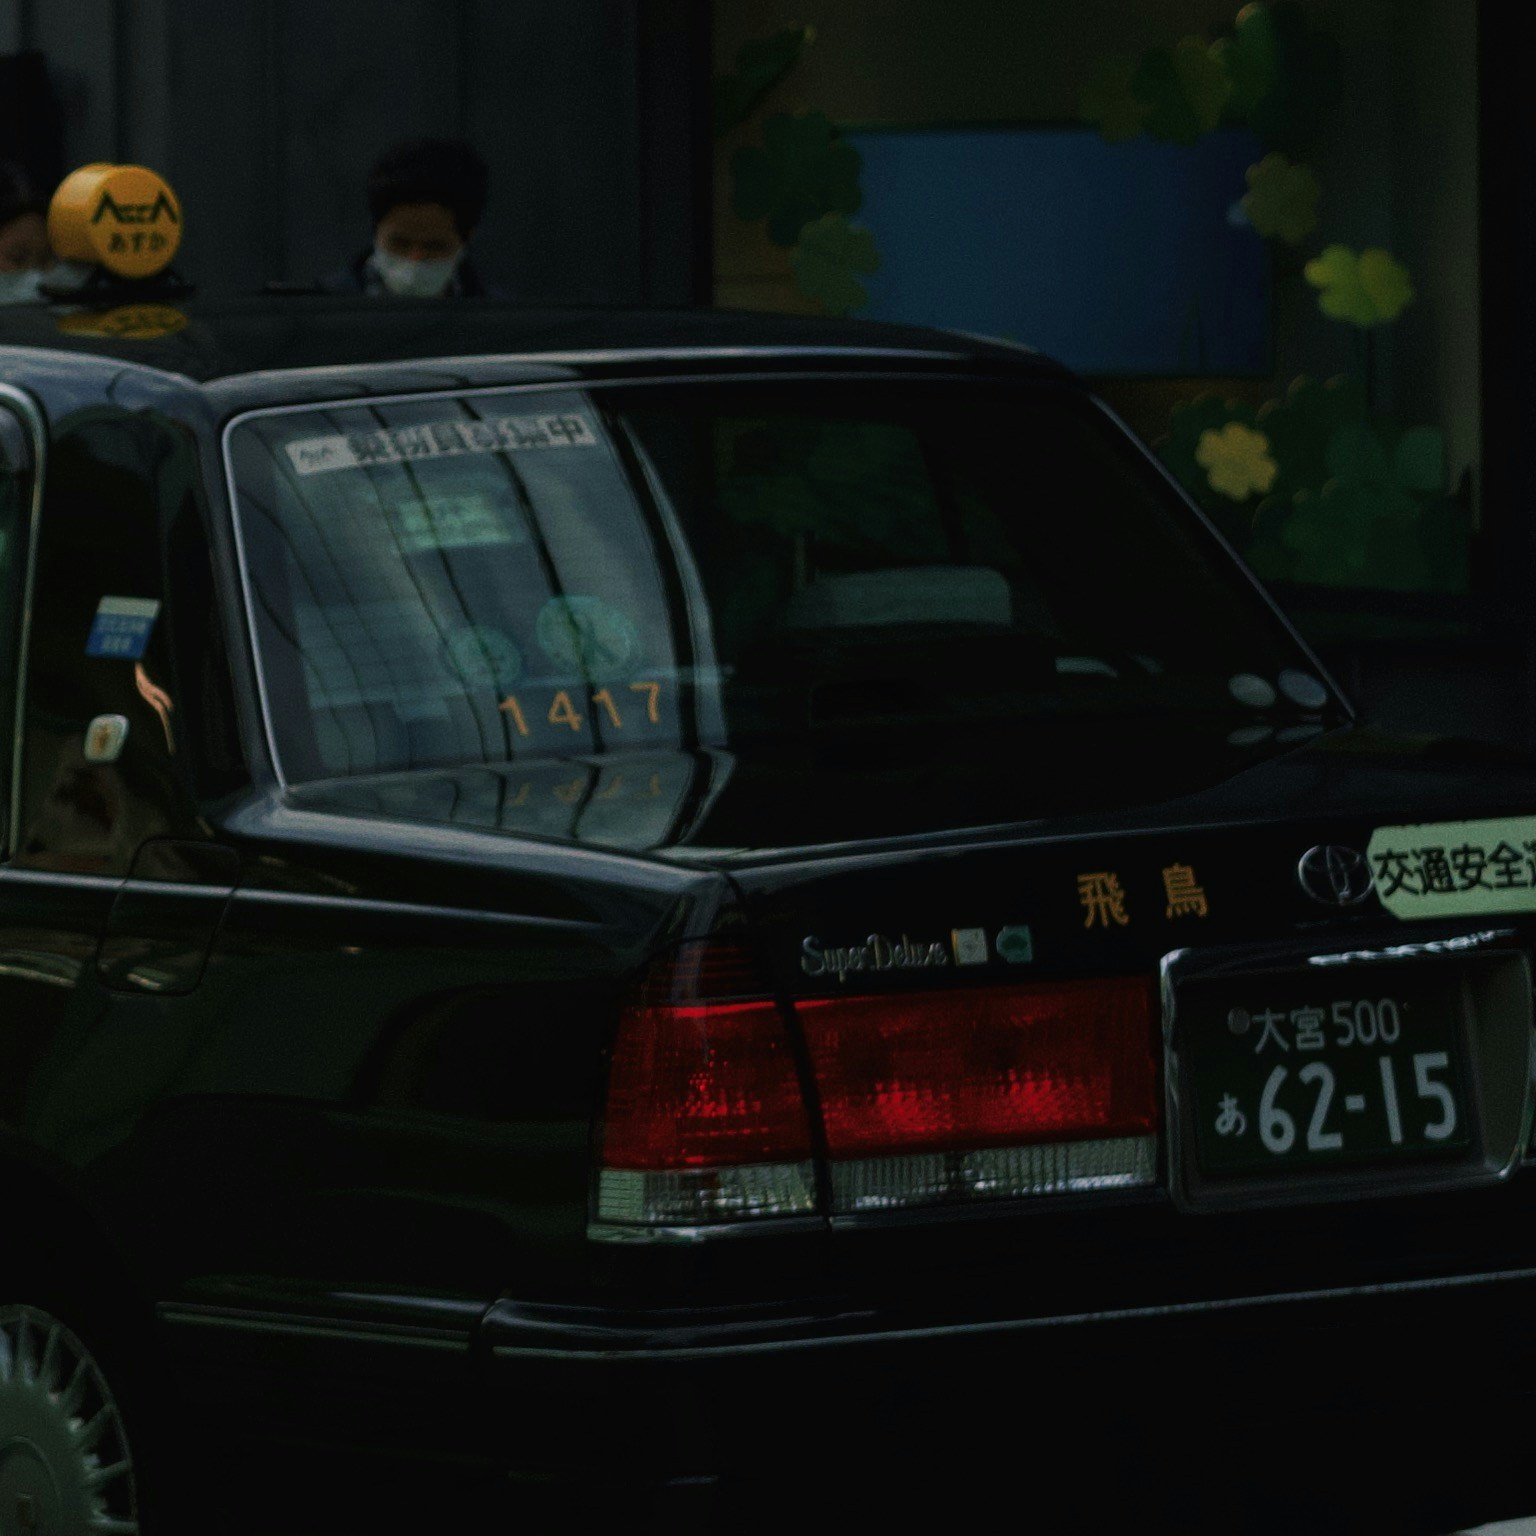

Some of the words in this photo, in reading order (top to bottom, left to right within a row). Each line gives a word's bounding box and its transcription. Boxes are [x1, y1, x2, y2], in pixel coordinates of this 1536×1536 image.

[498, 681, 661, 737] 1417
[800, 935, 866, 983] Super
[866, 932, 949, 972] Deluxe
[1214, 1091, 1248, 1138] あ
[1258, 1051, 1457, 1155] 62-15
